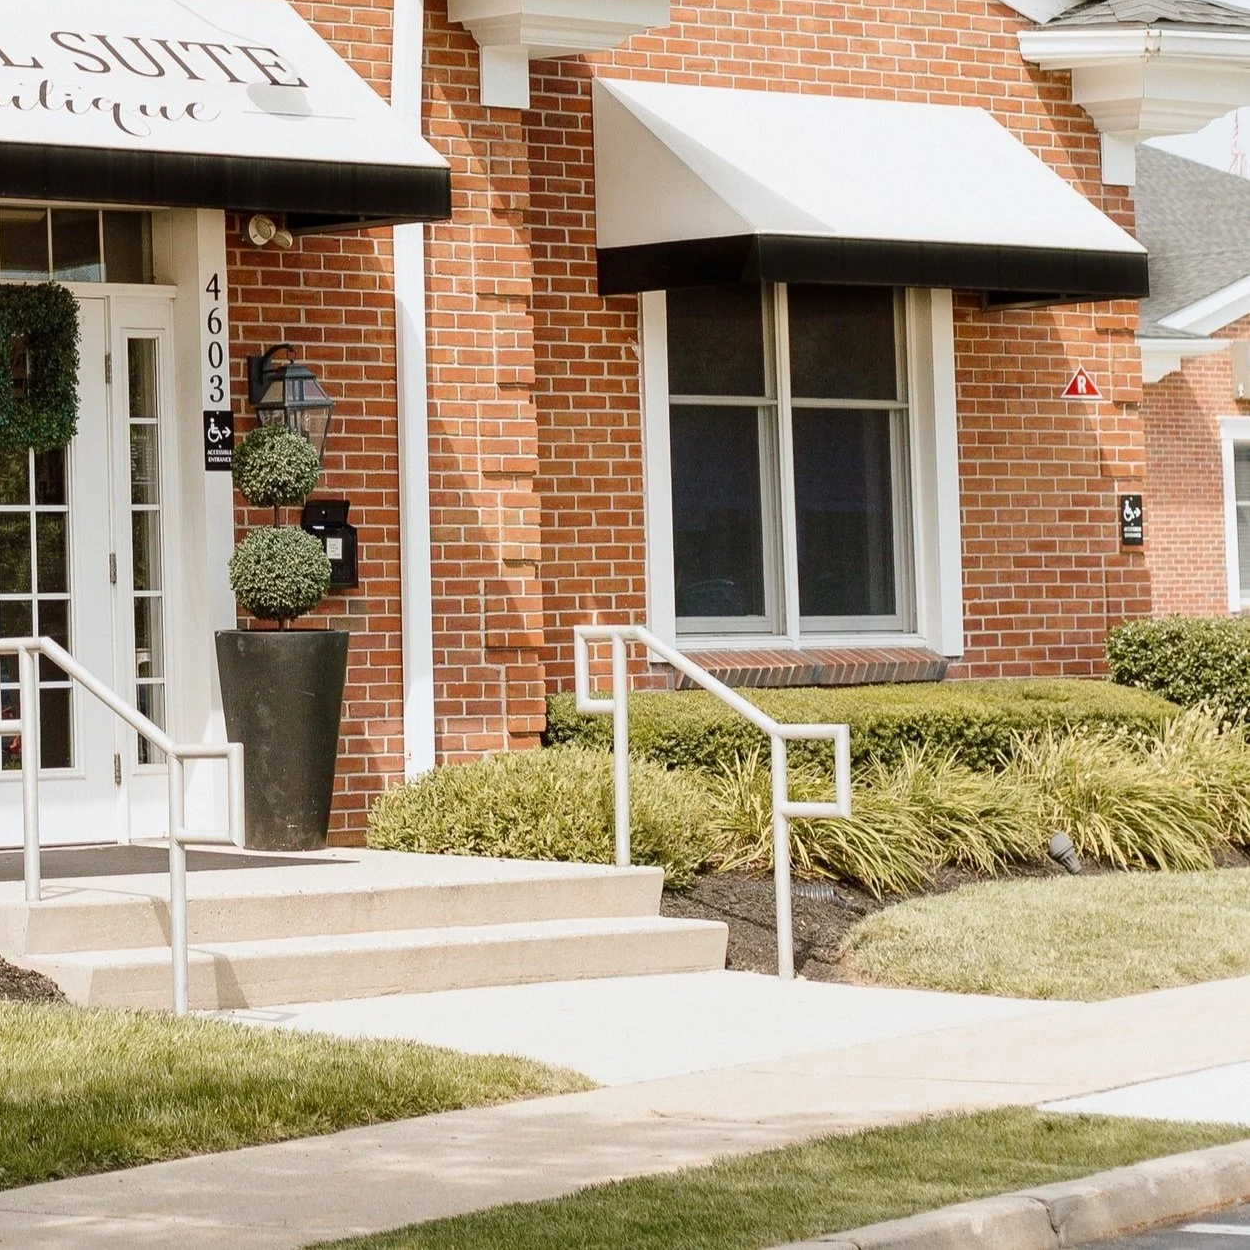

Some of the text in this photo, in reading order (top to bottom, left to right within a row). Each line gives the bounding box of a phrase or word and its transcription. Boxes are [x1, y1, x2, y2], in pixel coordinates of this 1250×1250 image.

[51, 31, 308, 88] SUITE
[206, 273, 224, 403] 4603
[1077, 375, 1087, 394] R
